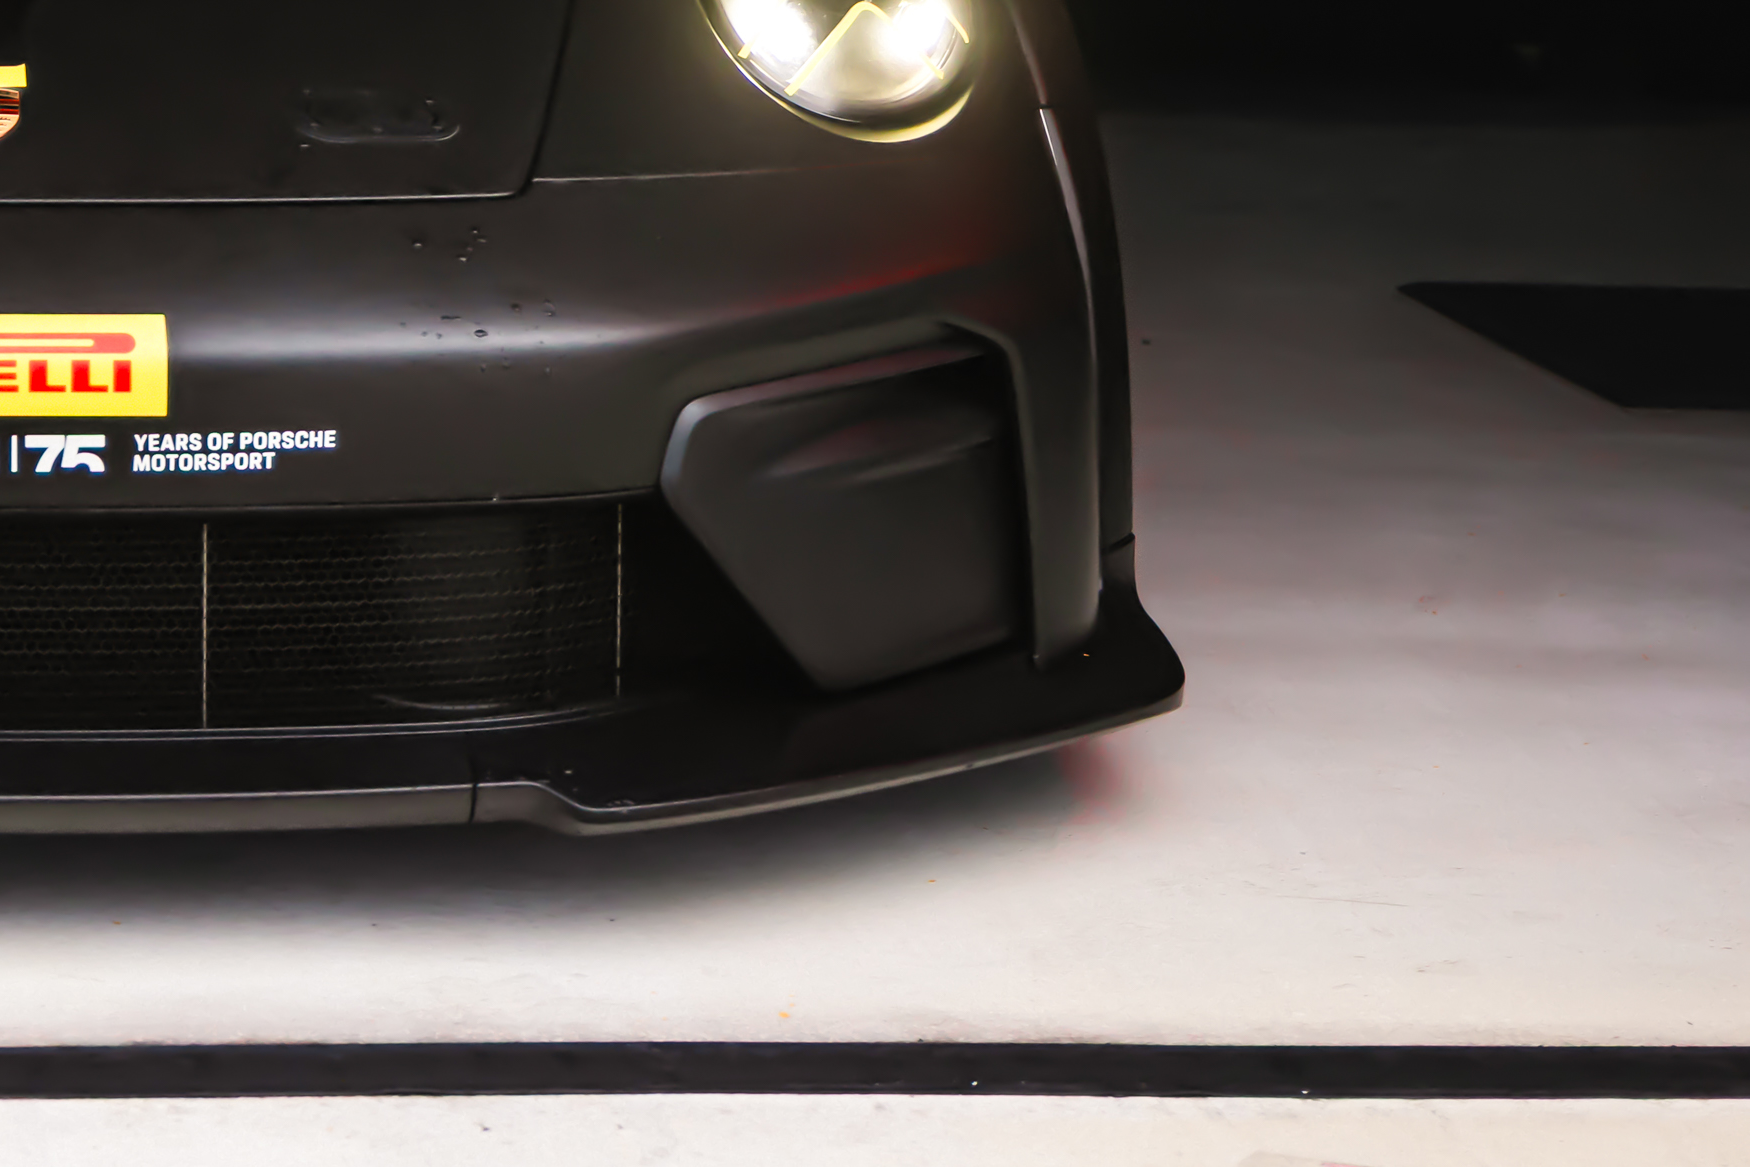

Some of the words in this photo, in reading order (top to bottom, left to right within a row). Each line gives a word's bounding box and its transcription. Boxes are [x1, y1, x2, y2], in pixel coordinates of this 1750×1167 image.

[133, 433, 202, 452] YEARS
[206, 432, 235, 450] OF
[239, 429, 337, 450] PORSCHE
[24, 434, 106, 473] 75
[132, 451, 276, 472] MOTORSPORT
